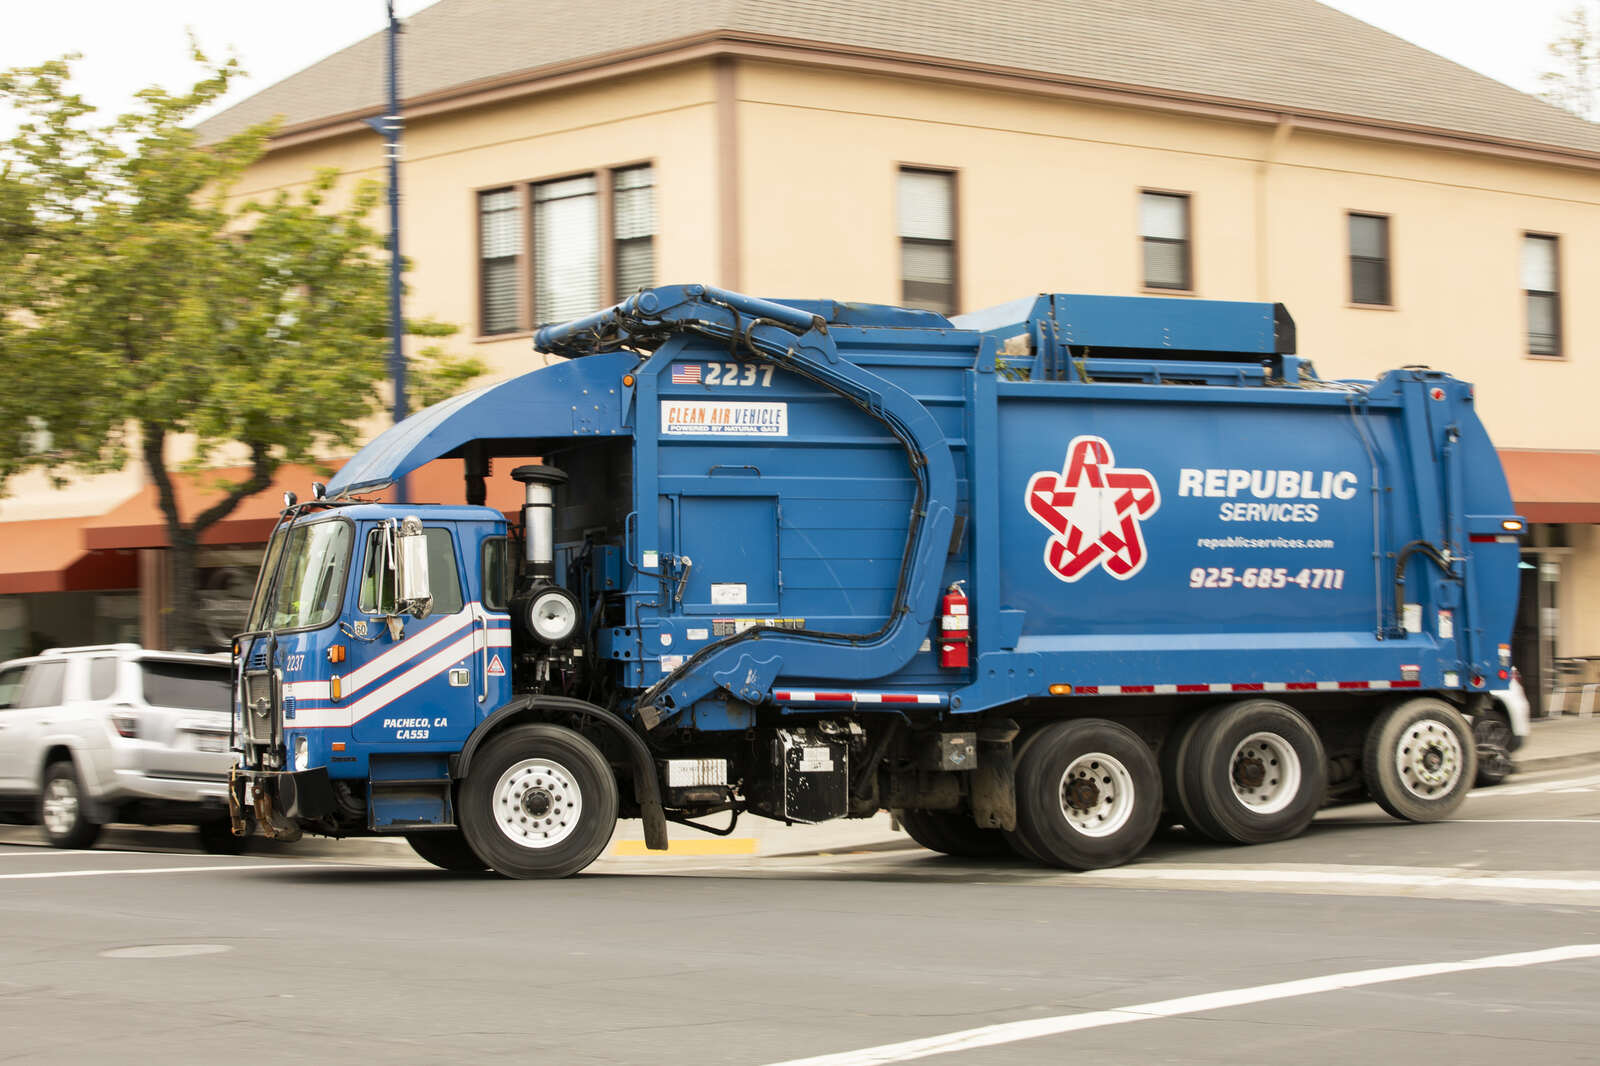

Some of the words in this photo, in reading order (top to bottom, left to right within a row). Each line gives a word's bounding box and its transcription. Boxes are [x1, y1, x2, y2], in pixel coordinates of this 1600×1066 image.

[705, 362, 775, 387] 2237
[668, 407, 706, 424] CLEAN
[710, 408, 731, 425] AIR
[735, 408, 782, 425] VEHICLE
[1178, 468, 1359, 500] REPUBLIC
[1218, 502, 1320, 523] SERVICES
[1197, 536, 1335, 550] republicservices.com
[1189, 567, 1345, 590] 925-685-4711
[286, 654, 305, 672] 2237
[383, 718, 431, 728] PACHECO,
[434, 717, 448, 727] CA
[396, 729, 430, 740] CA553
